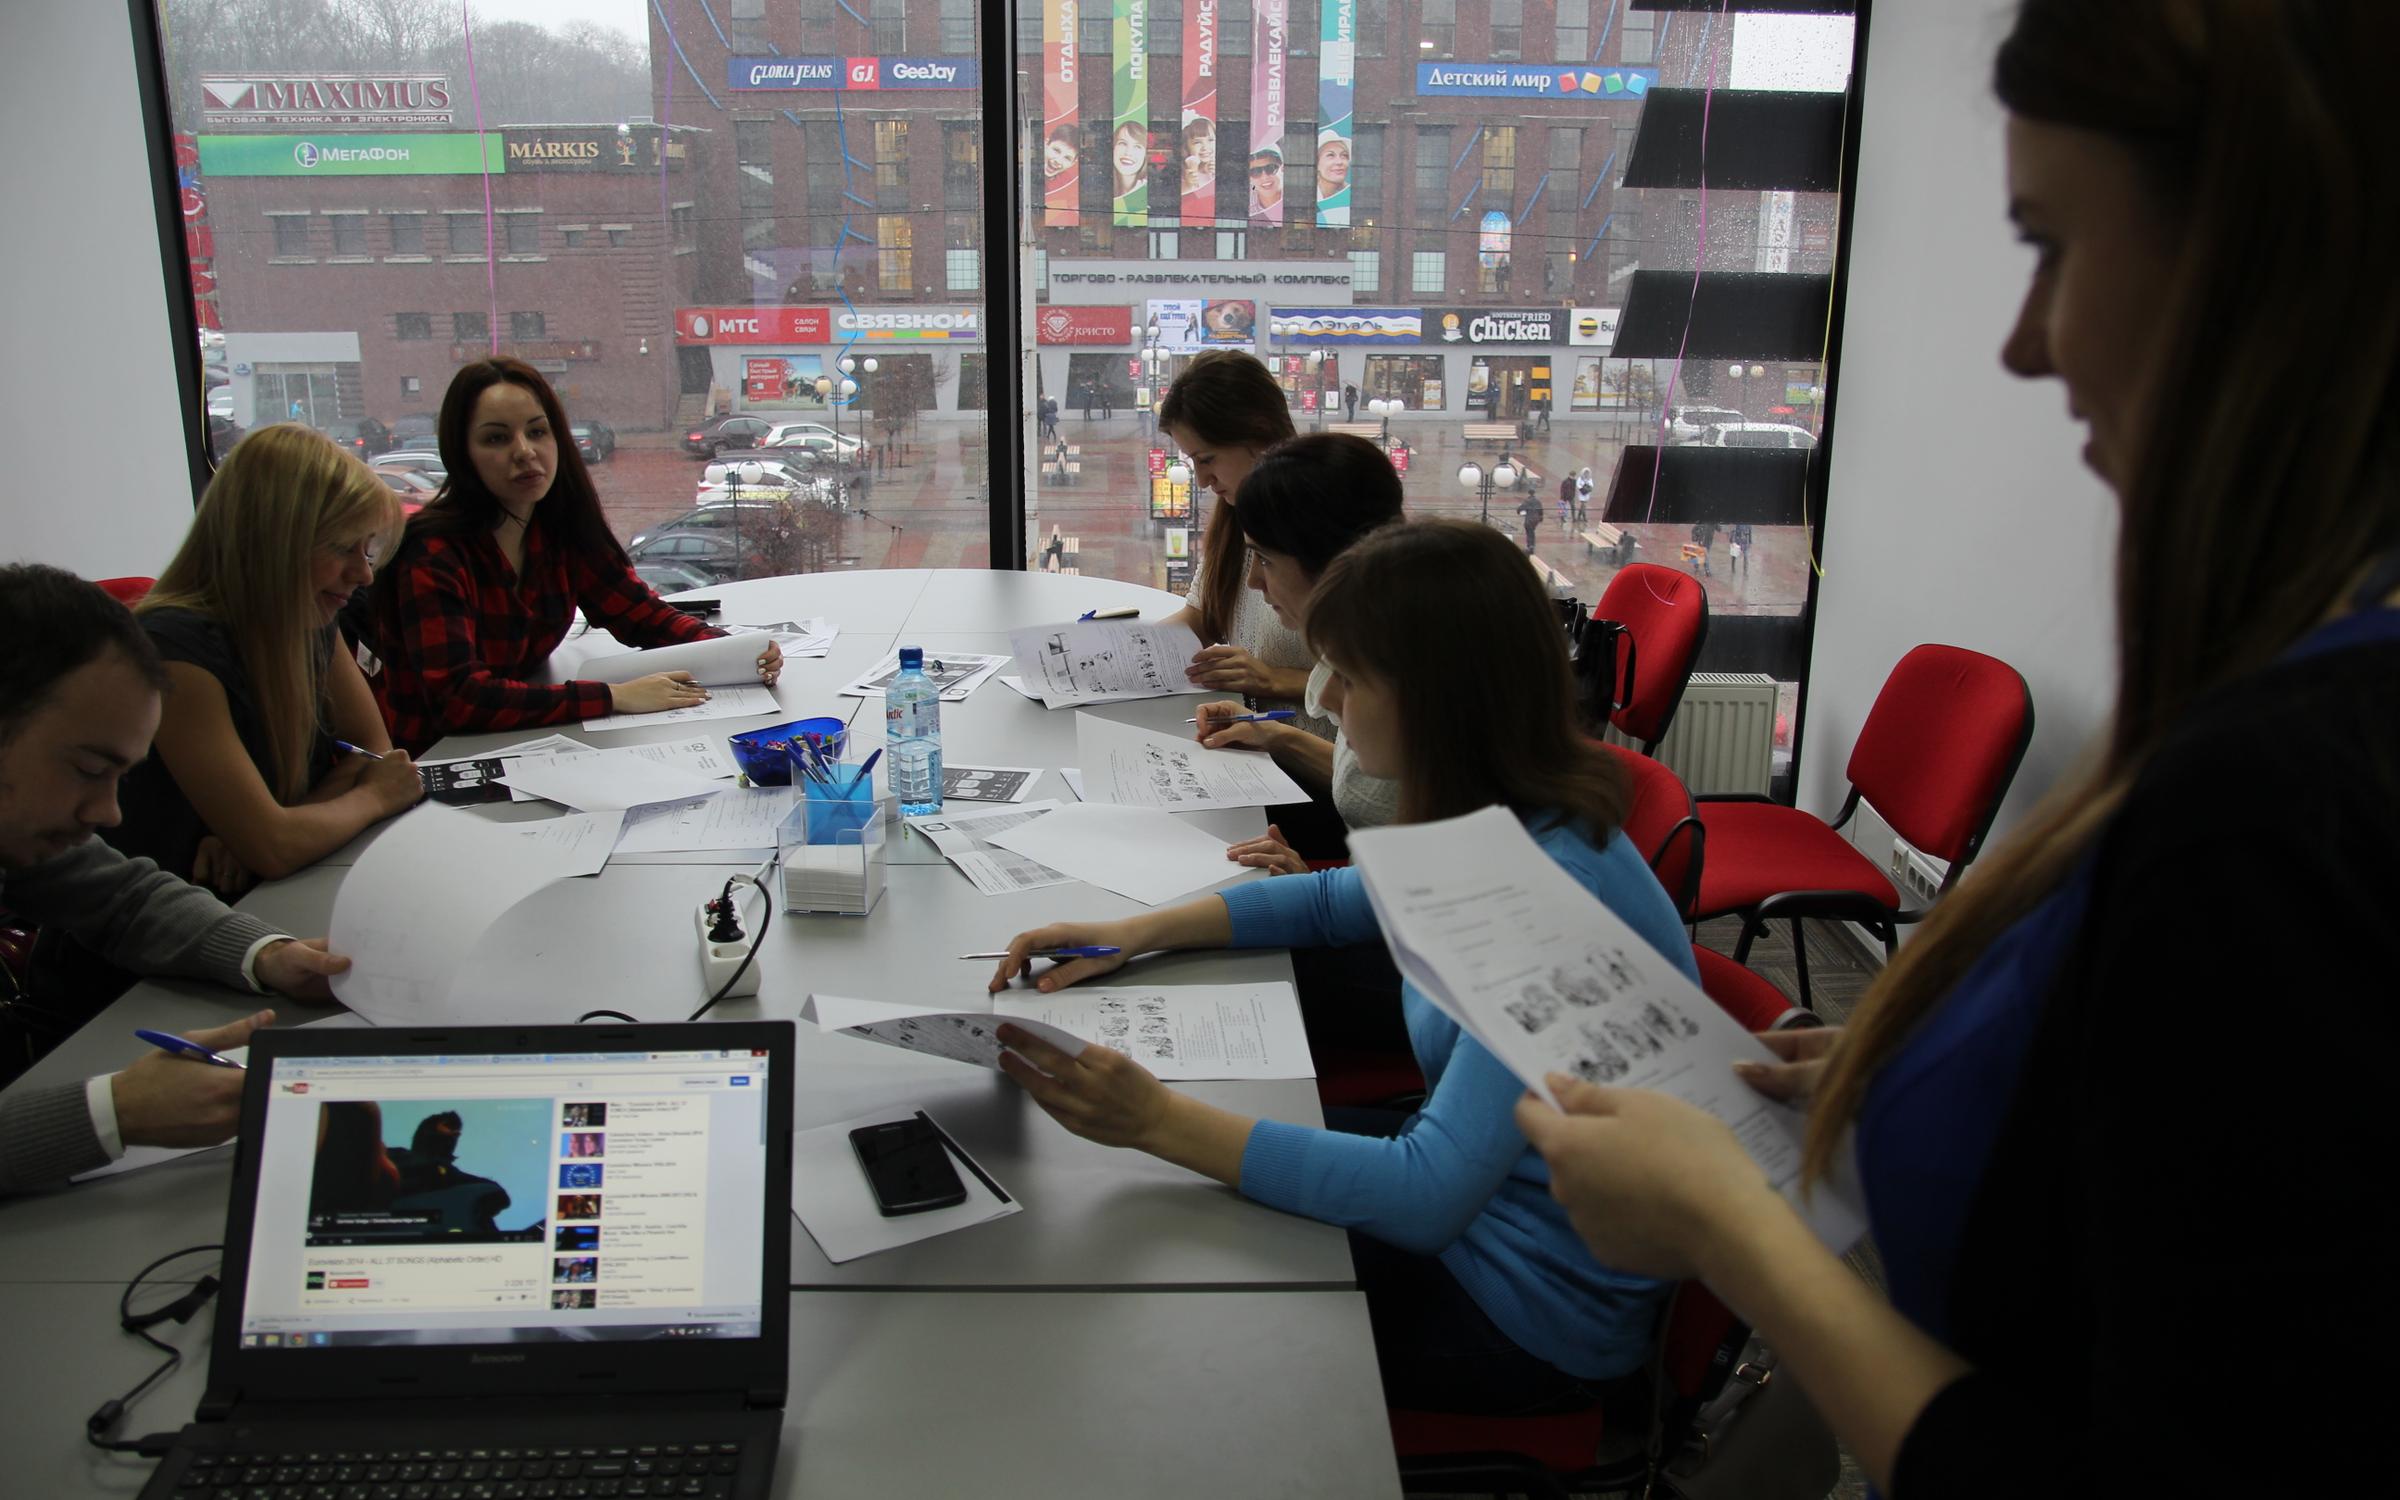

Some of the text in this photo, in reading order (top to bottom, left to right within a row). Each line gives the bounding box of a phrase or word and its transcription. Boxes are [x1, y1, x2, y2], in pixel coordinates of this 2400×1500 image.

[1060, 0, 1074, 83] ОТДЫХА
[1130, 0, 1144, 80] ПОКУПА
[892, 63, 956, 83] GeeJay
[1267, 0, 1283, 127] РАЗВЛЕКАЙС
[750, 64, 832, 85] GLORIA JEANS
[1428, 69, 1551, 92] Детский мир
[263, 80, 451, 110] MAXIMUS
[206, 116, 267, 124] БЫТОВАЯ
[358, 115, 449, 123] ЭЛЕКТРОНИКА
[509, 138, 600, 159] MÁRKIS
[1052, 273, 1117, 284] ТОРГОВО
[1126, 271, 1268, 285] РАЗВЛЕКАТЕЛЬНЫЙ
[1273, 274, 1351, 286] КОМПЛЕКС
[718, 318, 759, 334] МТС
[838, 309, 977, 329] СВЯЗНОЙ
[1522, 312, 1552, 322] FRIED
[1075, 326, 1116, 336] КРИСТО
[1469, 316, 1552, 343] Chicken
